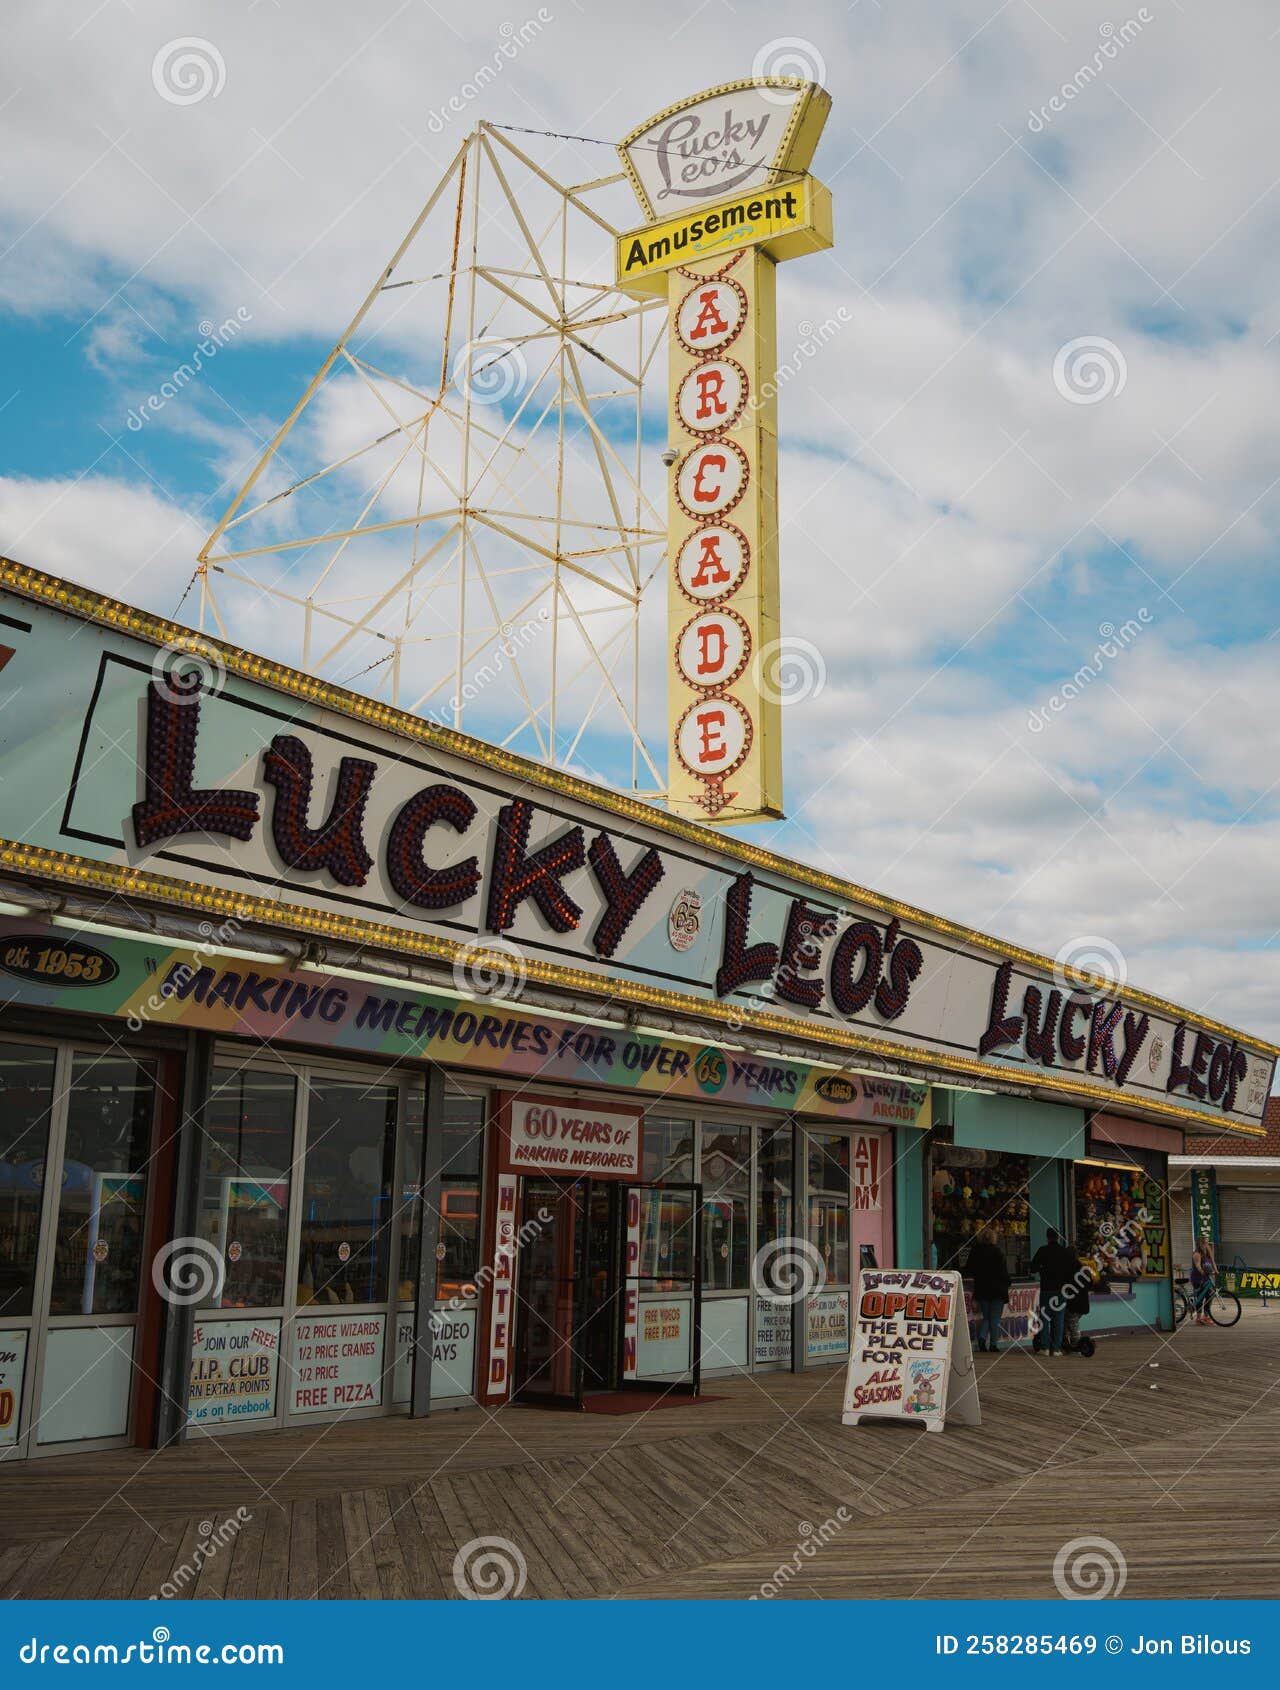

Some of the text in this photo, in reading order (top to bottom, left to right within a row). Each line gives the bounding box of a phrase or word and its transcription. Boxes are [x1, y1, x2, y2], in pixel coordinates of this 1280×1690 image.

[625, 191, 797, 271] Amusement
[690, 290, 730, 763] ARCADE
[5, 947, 103, 981] est. 1953
[356, 995, 552, 1056] MEMORIES
[558, 1030, 617, 1066] FOR
[622, 1041, 691, 1078] OVER
[698, 1054, 721, 1086] 65
[872, 1102, 916, 1120] ARCADE
[525, 1107, 631, 1145] 60 YEARS OF
[515, 1144, 635, 1168] MAKING MEMORIES
[855, 1136, 870, 1210] ATM
[1144, 1228, 1165, 1274] WIN
[625, 1194, 639, 1372] OPEN
[757, 1300, 772, 1312] FREE
[861, 1291, 951, 1321] OPEN
[204, 1336, 226, 1351] JOIN
[230, 1335, 249, 1349] OUR
[251, 1327, 278, 1349] FREE
[297, 1322, 380, 1339] 1/2 PRICE WIZARDS
[433, 1322, 470, 1341] VIDEO
[758, 1330, 773, 1342] FREE
[859, 1321, 948, 1337] THE FUN
[299, 1342, 375, 1360] 1/2 PRICE CRANES
[868, 1335, 935, 1351] PLACE
[229, 1356, 269, 1378] CLUB
[862, 1349, 903, 1364] FOR
[300, 1365, 339, 1382] 1/2 PRICE
[865, 1367, 901, 1386] ALL
[206, 1381, 236, 1396] EXTRA
[239, 1379, 270, 1393] POINTS
[296, 1383, 374, 1408] FREE PIZZA
[853, 1384, 903, 1408] SEASONS
[196, 1408, 207, 1418] us
[211, 1406, 224, 1417] on
[227, 1399, 271, 1415] Facebook
